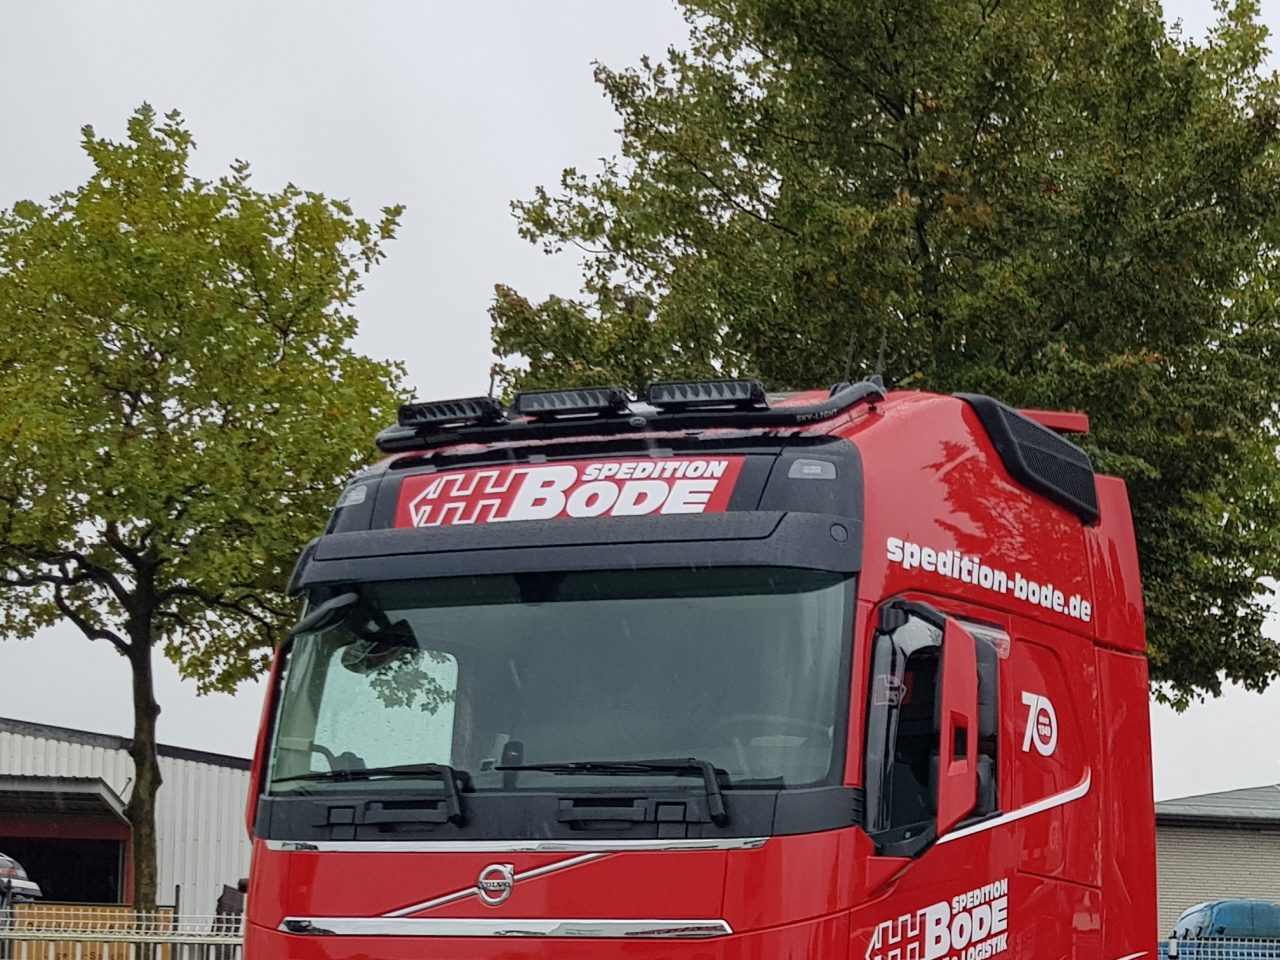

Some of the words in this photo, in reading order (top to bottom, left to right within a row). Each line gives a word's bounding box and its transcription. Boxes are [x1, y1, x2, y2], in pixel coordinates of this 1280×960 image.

[504, 465, 718, 522] BODE
[582, 460, 729, 481] SPEDITION
[886, 536, 1092, 623] spedition-bode.de
[1021, 690, 1058, 757] 70
[952, 878, 1008, 914] SPEDITION
[922, 896, 1008, 960] BODE
